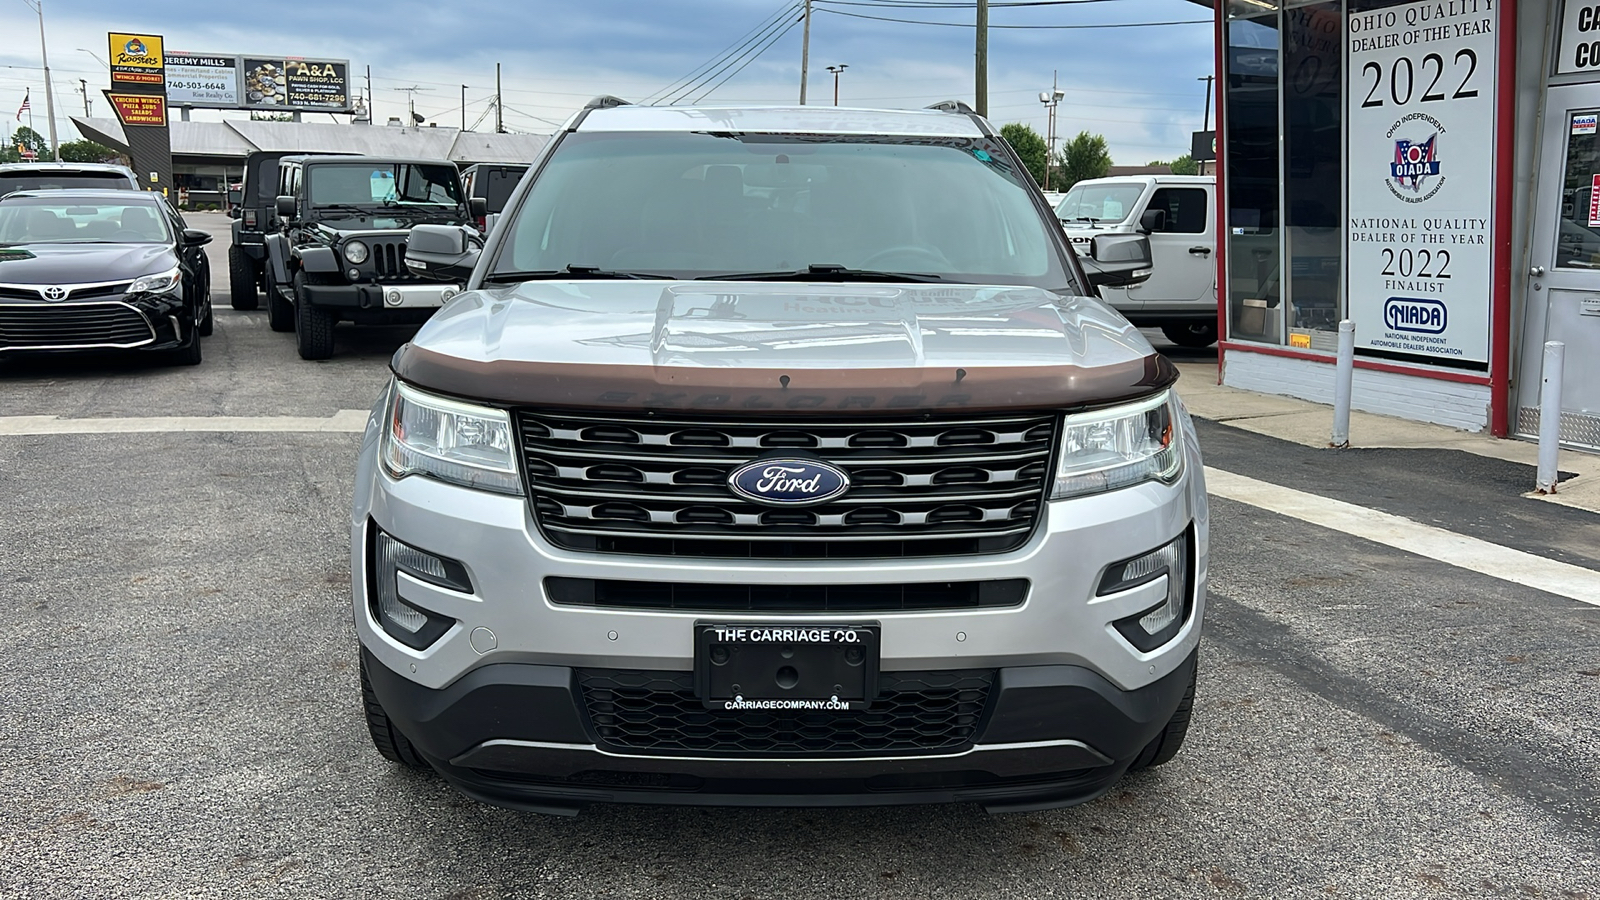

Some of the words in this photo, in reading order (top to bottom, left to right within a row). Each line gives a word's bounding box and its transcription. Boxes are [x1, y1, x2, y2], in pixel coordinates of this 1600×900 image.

[1350, 11, 1397, 33] OHIO
[1405, 0, 1494, 27] QUALITY
[1352, 33, 1400, 53] DEALER
[1403, 30, 1420, 45] OF
[1423, 25, 1450, 42] THE
[1454, 19, 1492, 38] YEAR
[116, 52, 158, 65] Roosters
[164, 57, 199, 65] JEREMY
[200, 58, 226, 66] MILLS
[297, 62, 337, 77] A&A
[1361, 48, 1479, 108] 2022
[167, 81, 226, 90] 740-503-6648
[1386, 120, 1401, 138] OHIO
[1401, 112, 1446, 134] INDEPENDENT
[1396, 162, 1432, 176] OIADA
[1384, 178, 1405, 201] AUTOMOBILE
[1423, 176, 1446, 201] ASSOCIATION
[1351, 218, 1417, 229] NATIONAL
[1423, 218, 1487, 231] QUALITY
[1352, 232, 1396, 242] DEALER
[1401, 233, 1416, 243] OF
[1421, 233, 1445, 244] THE
[1451, 234, 1485, 245] YEAR
[1381, 247, 1452, 279] 2022
[1385, 280, 1445, 293] FINALIST
[1389, 304, 1441, 328] NIADA
[1385, 332, 1410, 341] NATIONAL
[1411, 334, 1447, 345] INDEPENDENT
[1370, 339, 1402, 349] AUTOMOBILE
[1403, 342, 1425, 352] DEALERS
[1426, 345, 1463, 355] ASSOCIATION
[756, 466, 821, 493] Ford
[715, 629, 747, 642] THE
[750, 629, 830, 642] CARRIAGE
[834, 629, 861, 643] CO.
[725, 700, 849, 710] CARRIAGECOMPANY.COM
